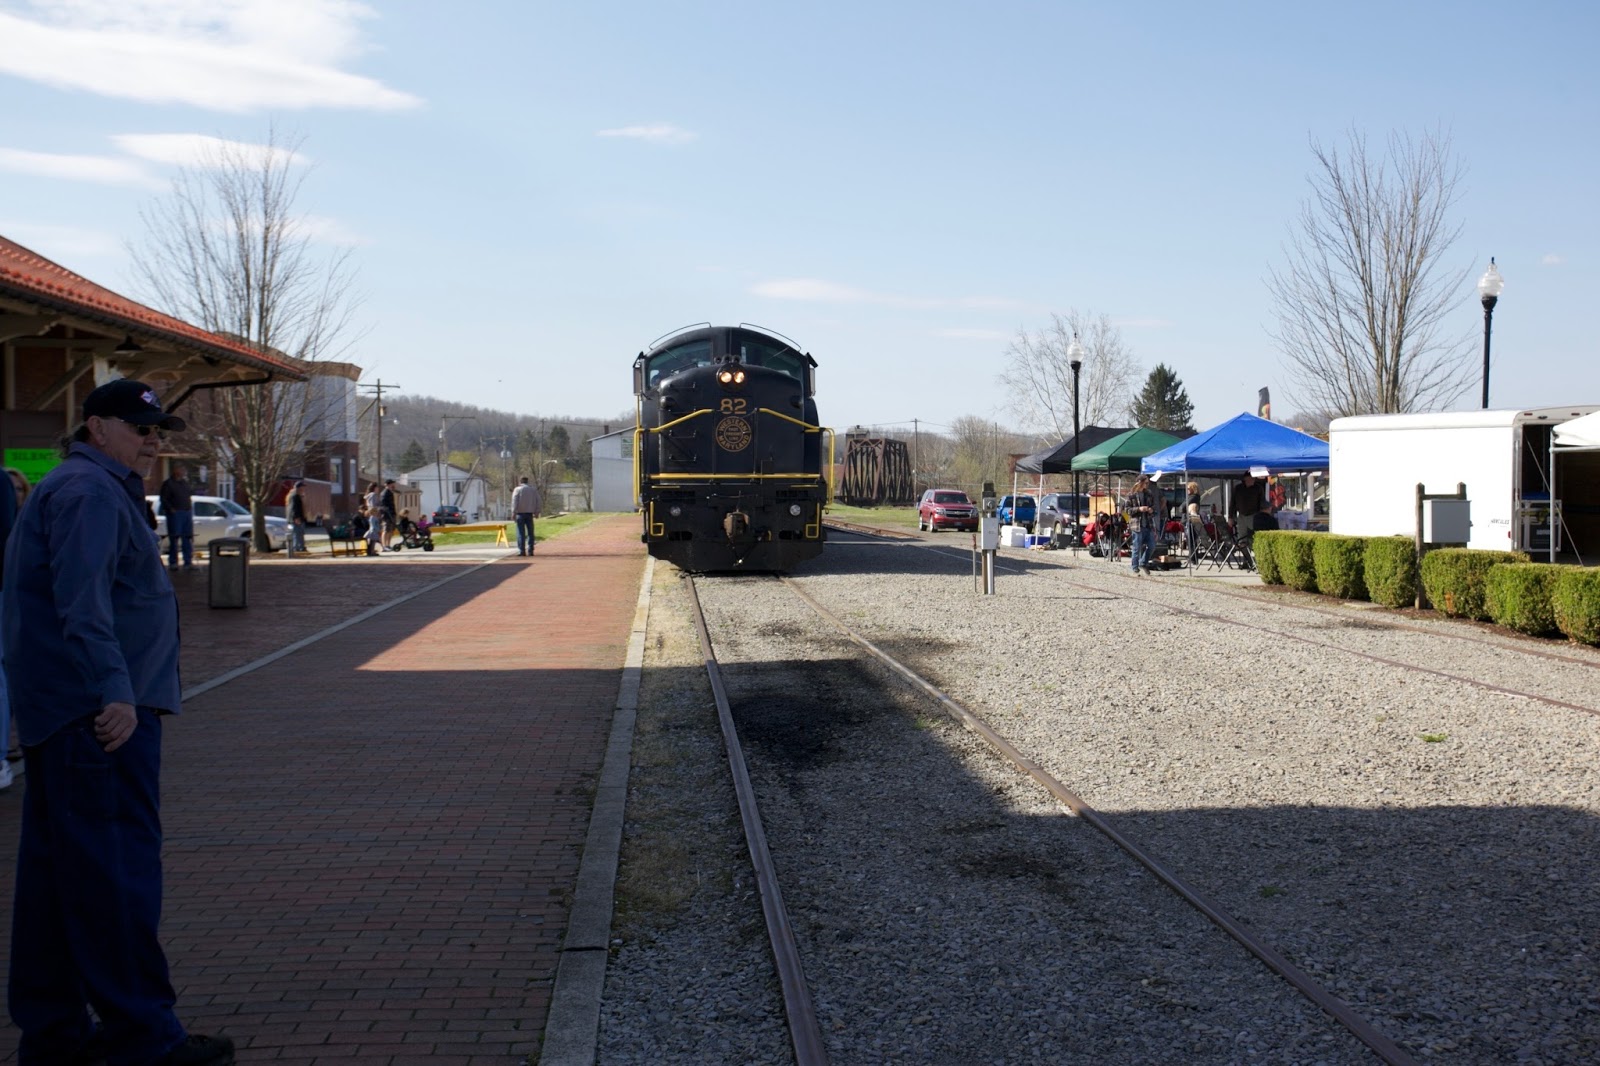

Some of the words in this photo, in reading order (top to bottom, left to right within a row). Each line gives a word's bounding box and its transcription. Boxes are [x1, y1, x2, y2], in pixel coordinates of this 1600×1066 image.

[720, 398, 747, 415] 82
[718, 418, 749, 431] WESTERN
[718, 435, 750, 450] MARYLAND
